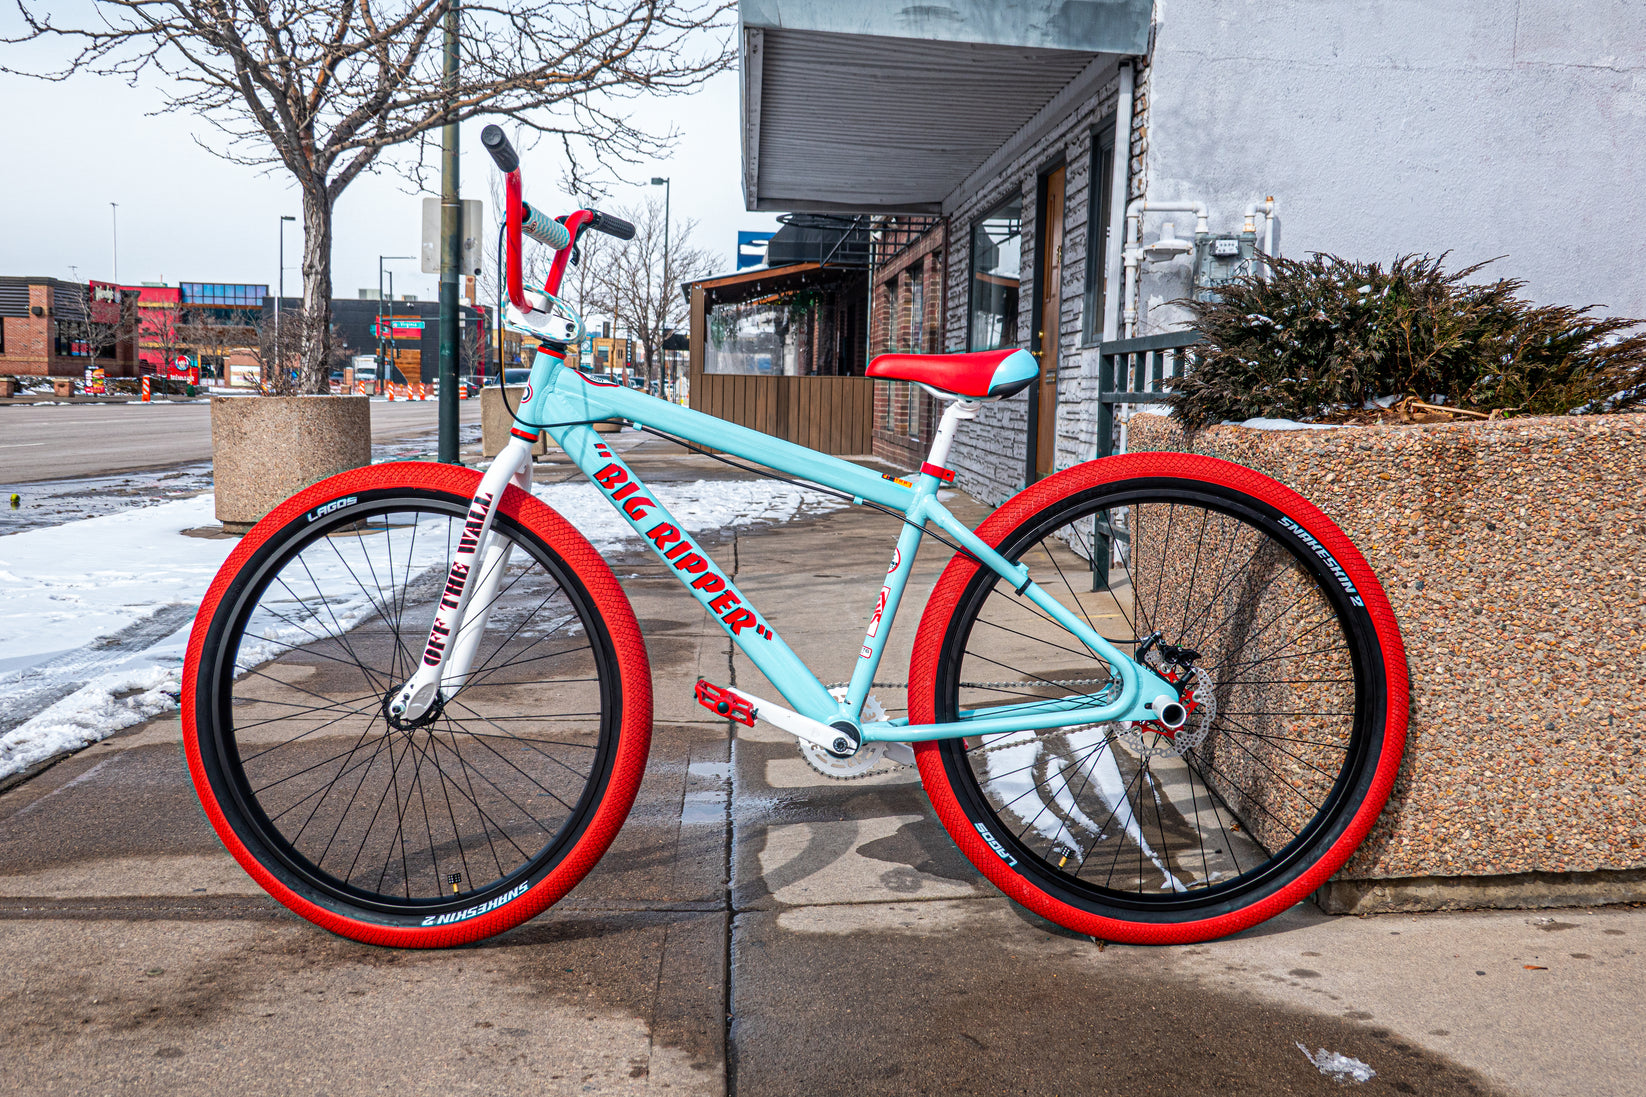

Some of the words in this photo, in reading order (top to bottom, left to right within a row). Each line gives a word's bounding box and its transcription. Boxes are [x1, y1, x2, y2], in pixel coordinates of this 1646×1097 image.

[307, 496, 358, 522] LAGOS
[424, 617, 451, 667] OFF
[440, 561, 470, 610] THE
[457, 492, 494, 554] WALL
[1277, 515, 1358, 593] SNAKESKIN
[1349, 594, 1365, 607] 2
[974, 822, 1018, 867] LAGOS
[421, 915, 437, 927] 2
[436, 879, 530, 925] SNAKESKIN
